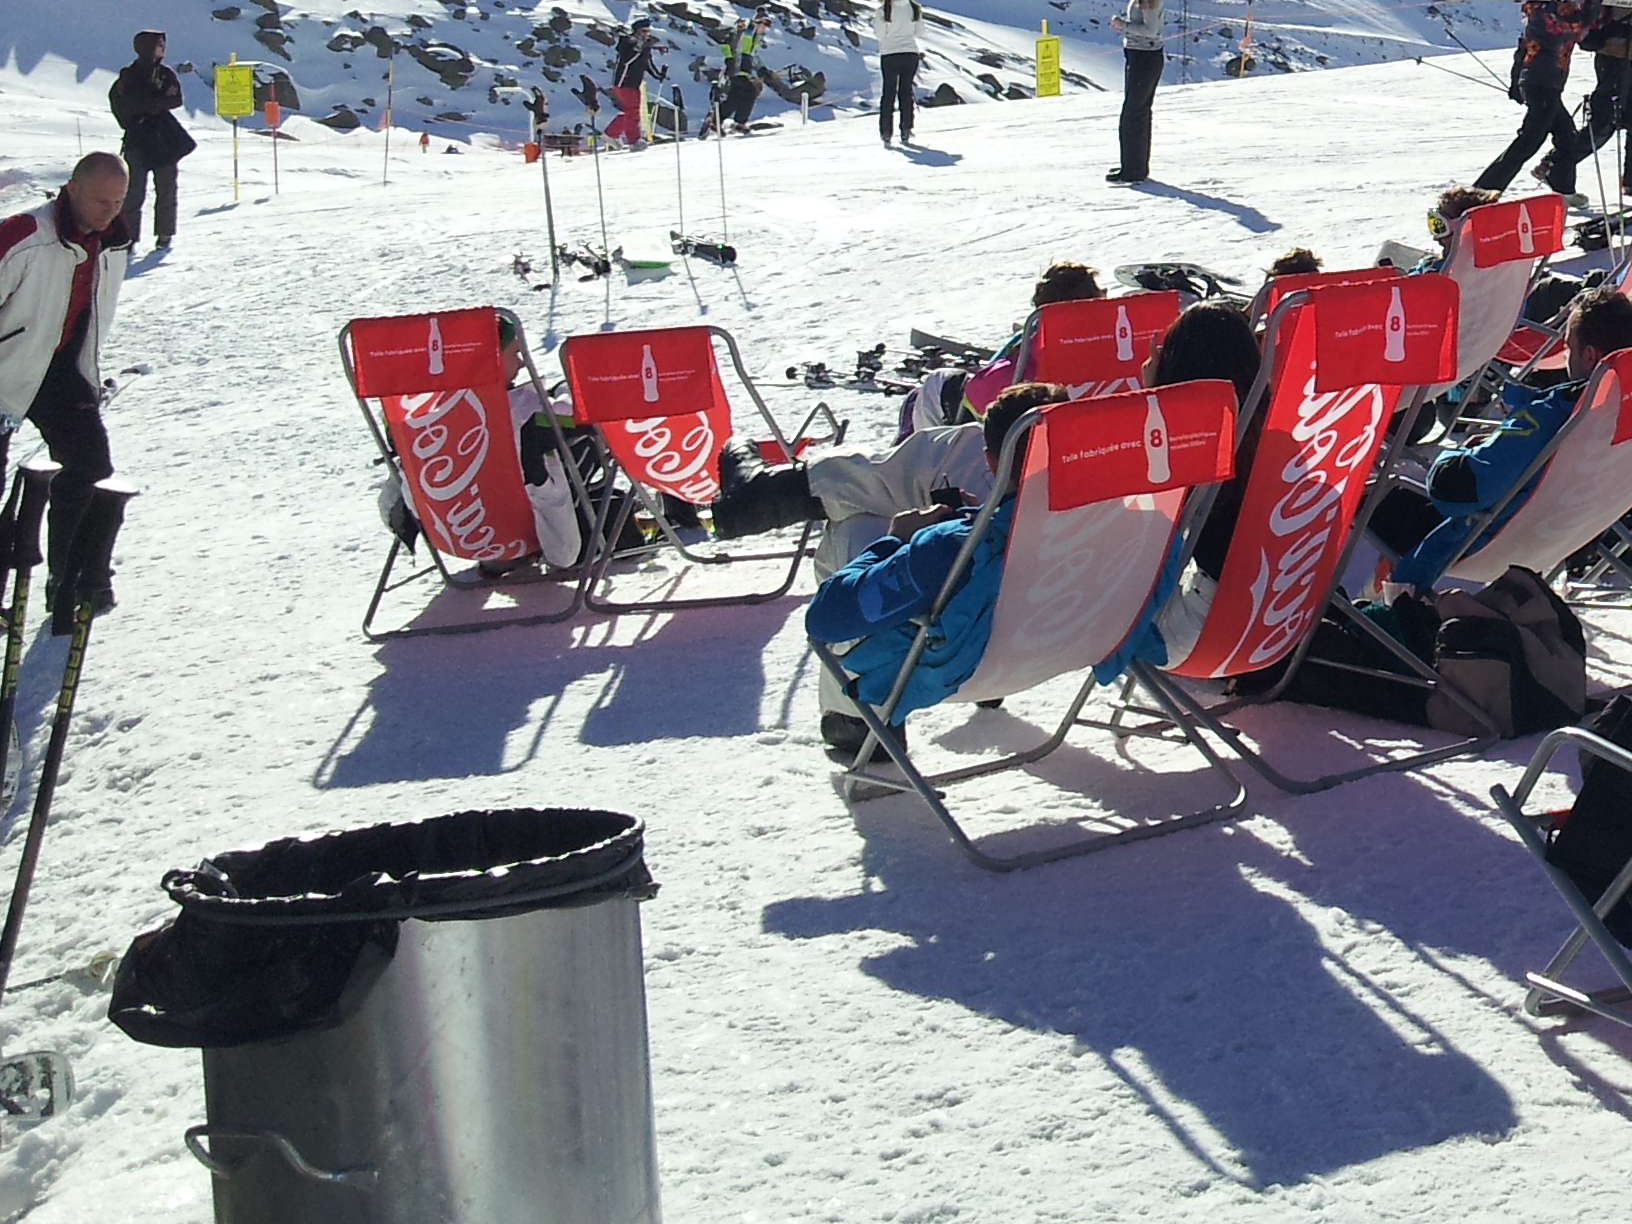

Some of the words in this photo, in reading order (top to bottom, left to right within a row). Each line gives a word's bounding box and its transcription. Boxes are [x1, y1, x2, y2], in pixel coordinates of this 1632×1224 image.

[1391, 316, 1400, 331] 8
[1120, 327, 1127, 338] 8
[432, 340, 438, 351] 8
[645, 367, 652, 378] 8
[1062, 453, 1078, 463] Toile
[1080, 443, 1119, 458] fabriquée
[1121, 440, 1141, 449] avec
[1151, 429, 1162, 448] 8
